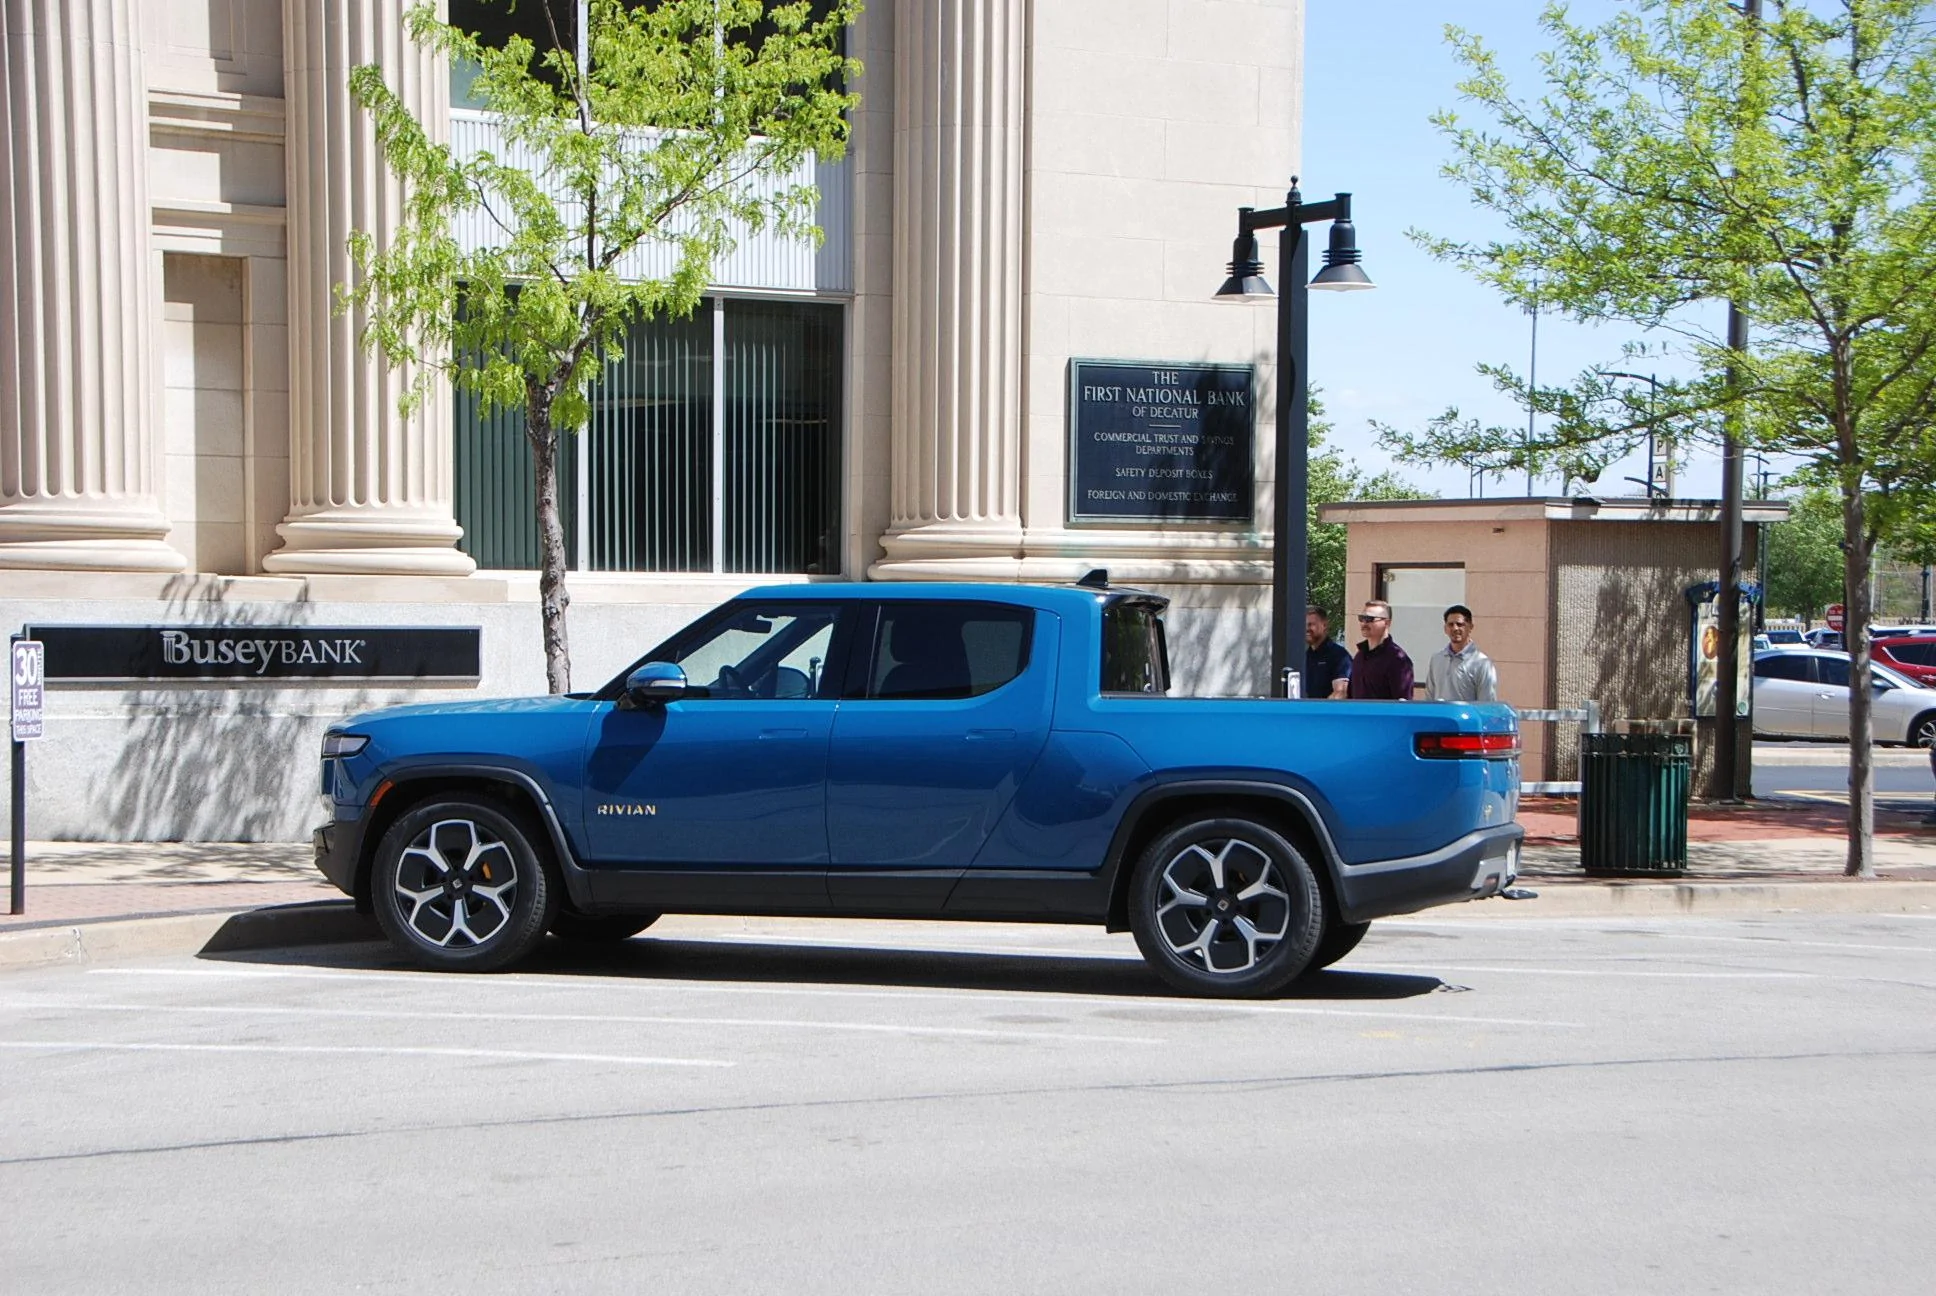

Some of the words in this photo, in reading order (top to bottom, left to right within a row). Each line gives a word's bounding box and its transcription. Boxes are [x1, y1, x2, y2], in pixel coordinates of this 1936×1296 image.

[1152, 371, 1179, 384] THE
[1084, 385, 1122, 402] FIRST
[1126, 387, 1201, 405] NATIONAL
[1208, 390, 1245, 406] BANK
[1132, 406, 1146, 417] OF
[1150, 407, 1199, 419] DECATUR
[1094, 431, 1151, 443] COMMERCIAL
[1154, 433, 1181, 443] TRUST
[1181, 434, 1199, 444] AND
[1201, 435, 1235, 446] SINGS
[1136, 445, 1194, 456] DEPARTMENTS
[1115, 467, 1146, 478] SAFETY
[1148, 468, 1184, 478] DEPOSIT
[1186, 469, 1213, 480] BOXES
[1087, 489, 1125, 500] FOREIGN
[1127, 489, 1146, 500] AND
[1148, 490, 1192, 501] DOMESTIC
[15, 647, 38, 686] 30
[18, 688, 39, 706] FREE
[15, 708, 42, 722] PARKING
[597, 804, 657, 816] RIVIAN
